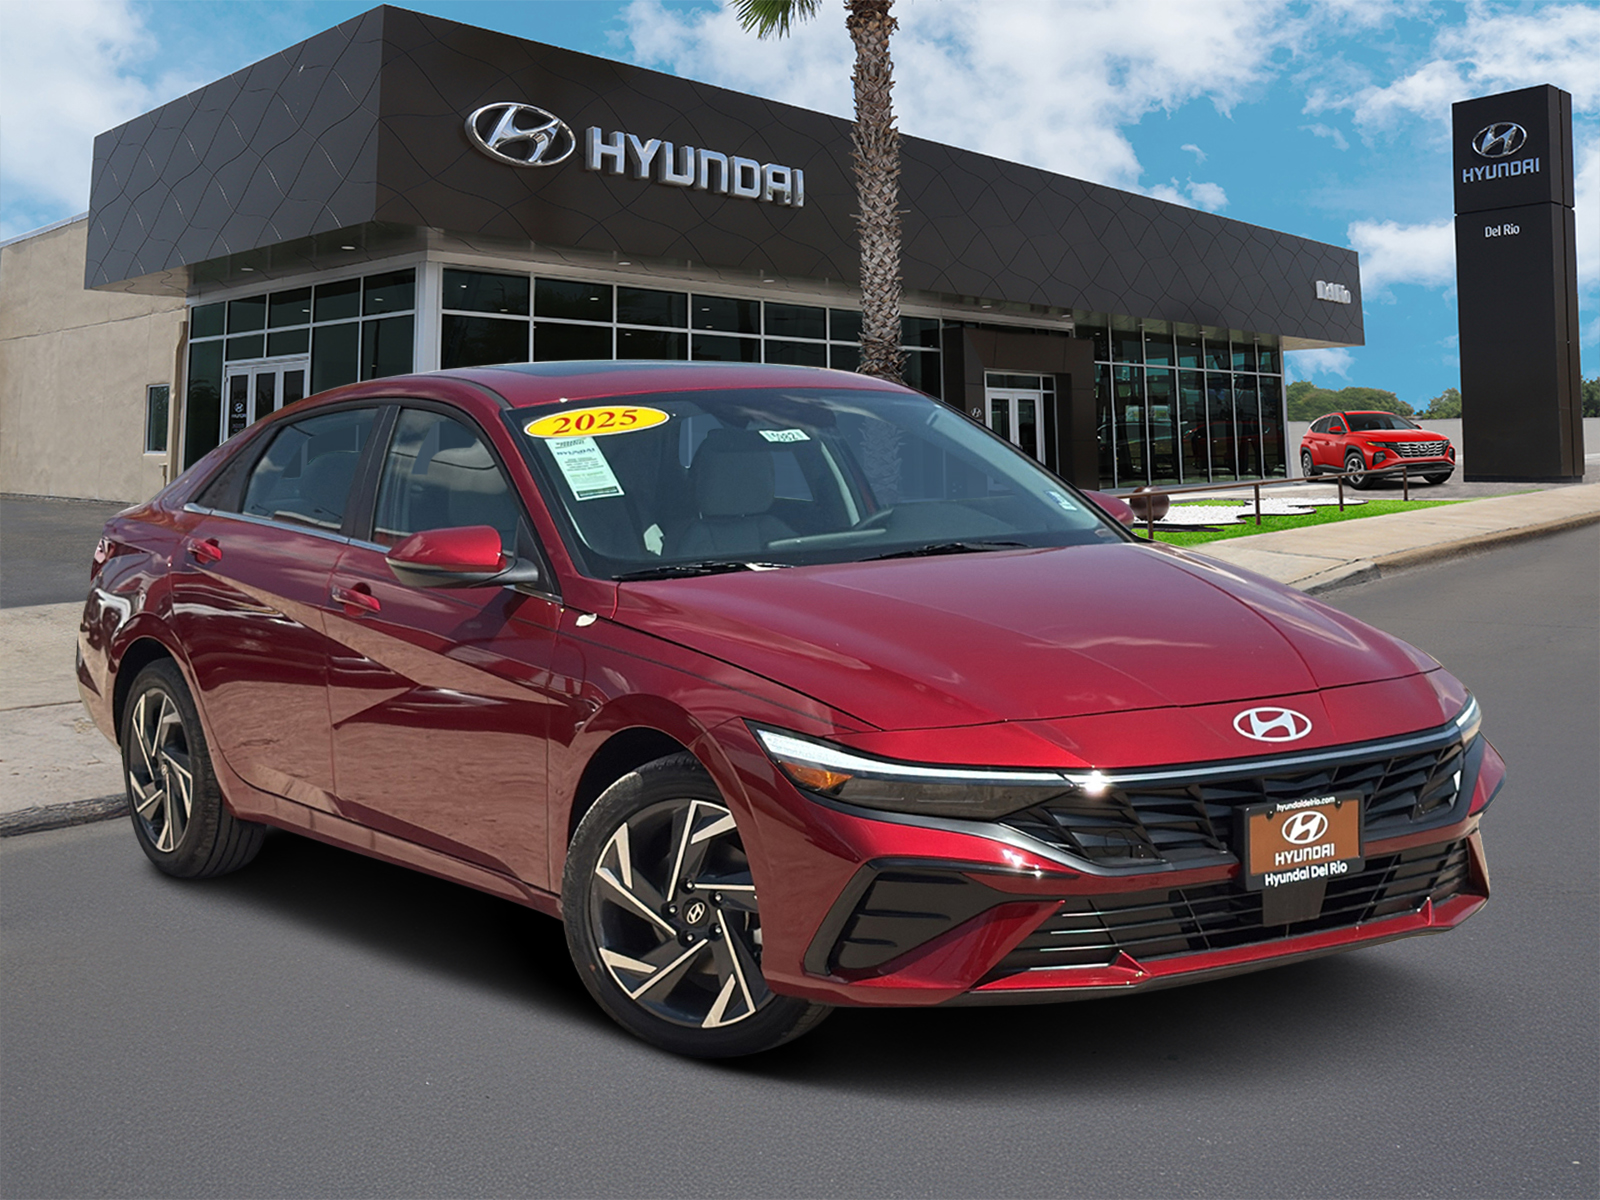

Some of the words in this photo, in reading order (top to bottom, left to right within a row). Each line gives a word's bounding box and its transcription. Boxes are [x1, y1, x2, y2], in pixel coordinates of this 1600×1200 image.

[586, 126, 804, 207] HYUNDAI
[1462, 157, 1540, 183] HYUNDAI
[1484, 225, 1501, 238] Del
[1503, 223, 1520, 235] Rio
[552, 409, 638, 435] 2025
[1276, 796, 1335, 812] hyundaidelrio.com
[1275, 843, 1335, 866] HYUNDAI
[1264, 865, 1310, 887] Hyundai
[1311, 863, 1328, 878] Del
[1329, 860, 1348, 875] Rio
